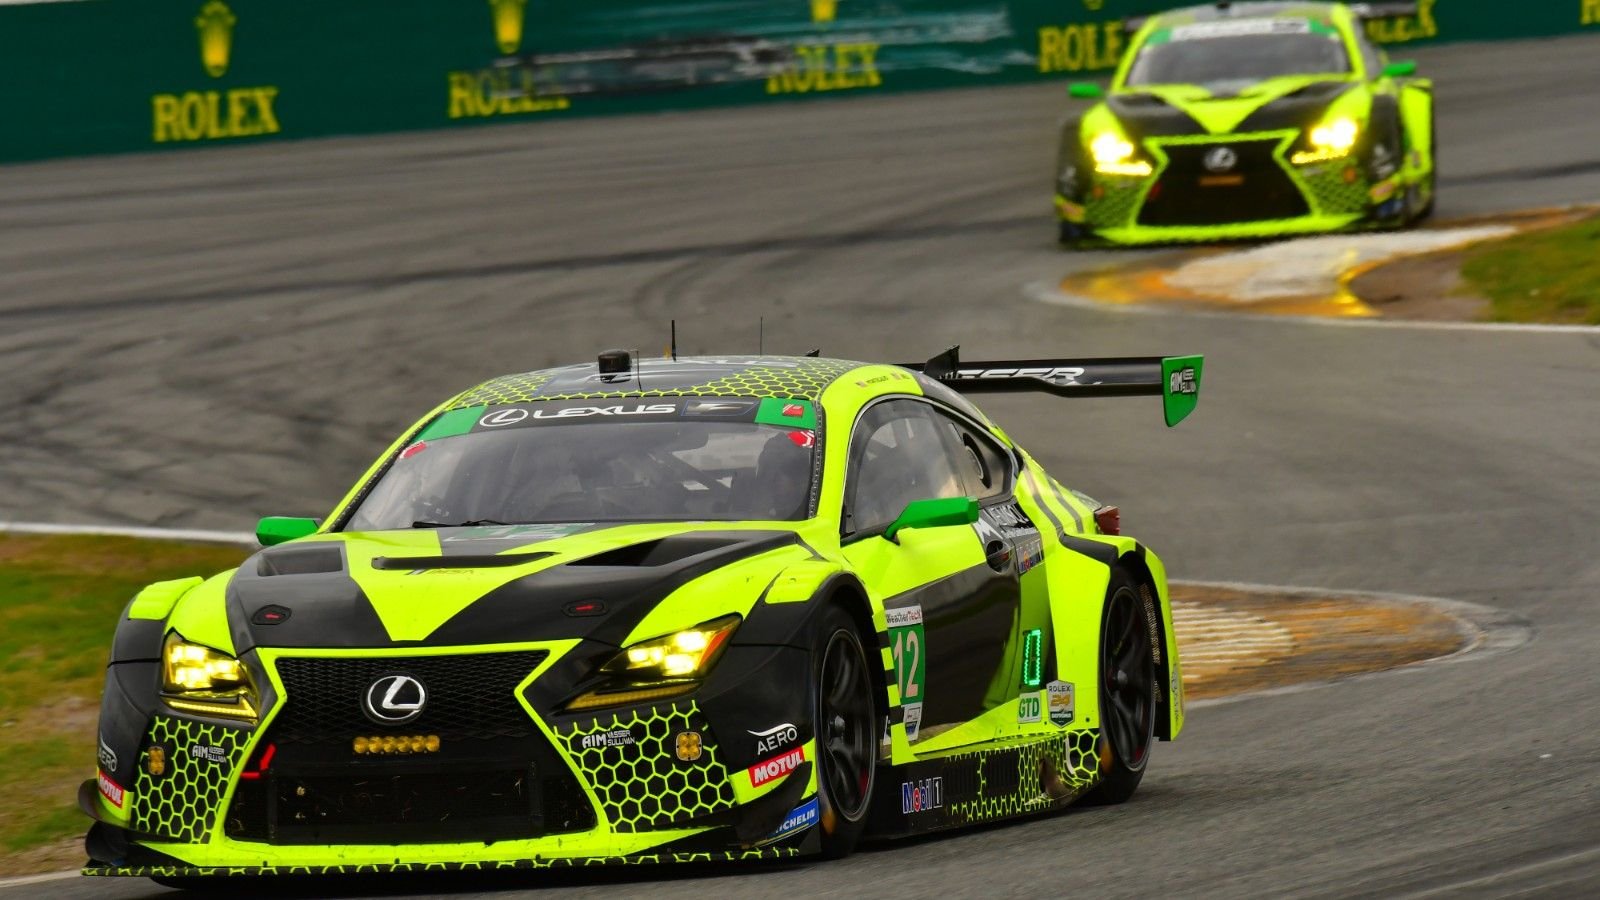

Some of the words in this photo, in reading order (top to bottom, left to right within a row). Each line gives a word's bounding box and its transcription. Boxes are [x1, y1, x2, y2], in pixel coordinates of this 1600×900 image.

[1038, 21, 1122, 73] ROLE
[153, 86, 279, 141] ROLEX
[533, 404, 676, 419] LEXUS
[893, 630, 919, 699] 12
[1048, 685, 1071, 693] ROLEX
[1018, 698, 1040, 719] GTD
[581, 734, 607, 749] AIM
[757, 727, 798, 756] AERO
[754, 751, 803, 784] MOTUL
[902, 778, 932, 814] Mobil
[775, 808, 816, 834] ICHELIN
